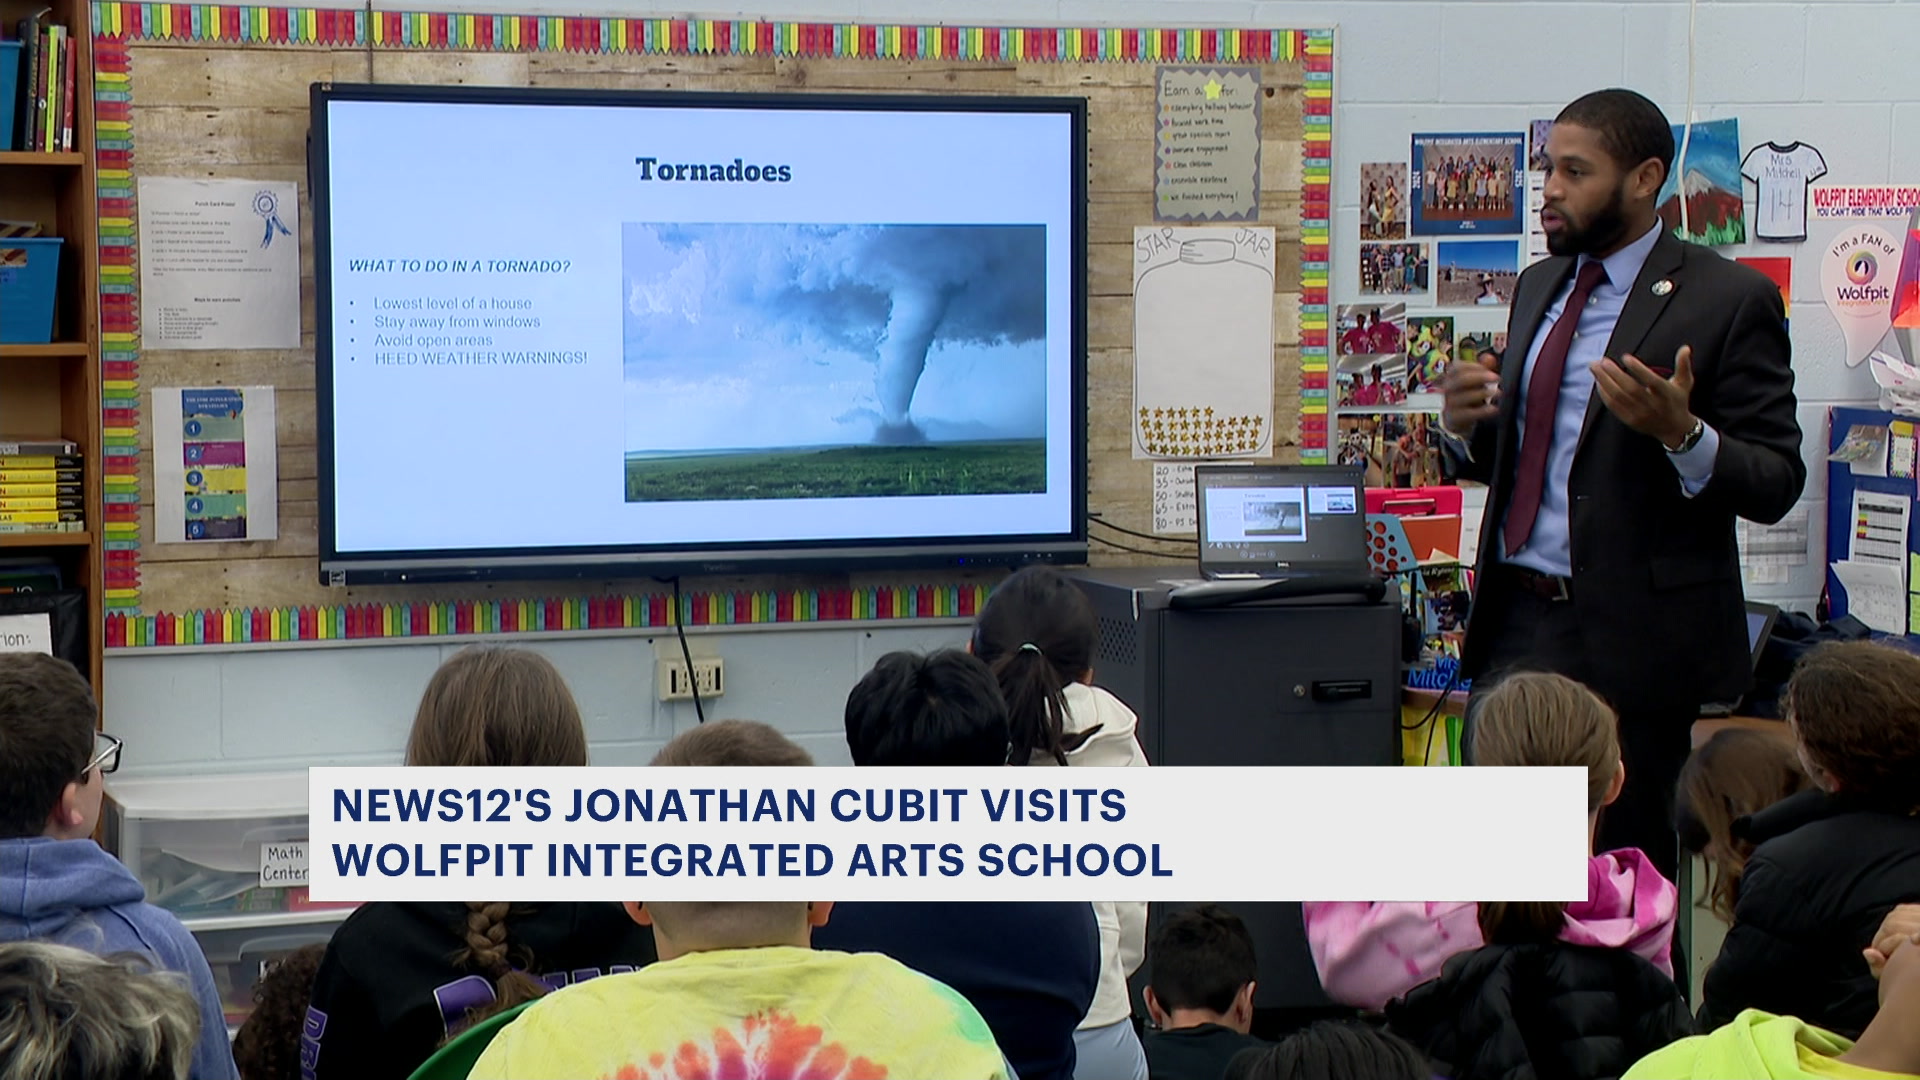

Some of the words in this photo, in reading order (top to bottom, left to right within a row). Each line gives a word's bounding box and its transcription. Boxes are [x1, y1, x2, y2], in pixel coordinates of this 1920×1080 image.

[1165, 80, 1190, 97] Earn
[635, 157, 792, 182] Tornadoes
[1765, 166, 1801, 179] Mitchell
[1813, 188, 1846, 206] WOLFPIT
[1848, 188, 1895, 206] ELEMENTARY
[1771, 188, 1793, 222] 14
[1817, 208, 1829, 216] YOU
[1831, 208, 1850, 216] CAN'T
[1851, 208, 1866, 216] HIDE
[1868, 208, 1883, 216] THAT
[1886, 208, 1903, 216] WOLF
[1136, 227, 1181, 263] STAR
[1235, 229, 1271, 258] JAR
[1832, 241, 1850, 257] I'm
[1852, 237, 1859, 245] a
[1861, 233, 1883, 246] FAN
[1883, 244, 1896, 256] of
[350, 259, 397, 273] WHAT
[400, 259, 421, 273] TO
[424, 260, 448, 273] DO
[452, 260, 468, 273] IN
[471, 260, 482, 273] A
[487, 260, 571, 273] TORNADO?
[1837, 286, 1889, 302] Wolfpit
[374, 296, 423, 310] Lowest
[427, 296, 458, 310] level
[462, 296, 475, 310] of
[479, 300, 487, 310] a
[491, 297, 533, 310] house
[375, 315, 405, 331] Stay
[410, 318, 445, 331] away
[449, 315, 480, 329] from
[483, 315, 541, 329] windows
[375, 333, 413, 347] Avoid
[417, 336, 451, 349] open
[455, 336, 493, 347] areas
[375, 352, 418, 366] HEED
[421, 352, 498, 366] WEATHER
[501, 351, 588, 365] WARNINGS!
[190, 449, 197, 459] 2
[1155, 466, 1169, 476] 20
[191, 474, 198, 483] 3
[1155, 477, 1168, 488] 35
[1155, 491, 1168, 502] 50
[191, 501, 198, 511] 4
[1155, 502, 1168, 515] 65
[192, 525, 199, 535] 5
[1155, 517, 1168, 530] 80
[268, 846, 303, 862] Math
[263, 864, 309, 881] Center
